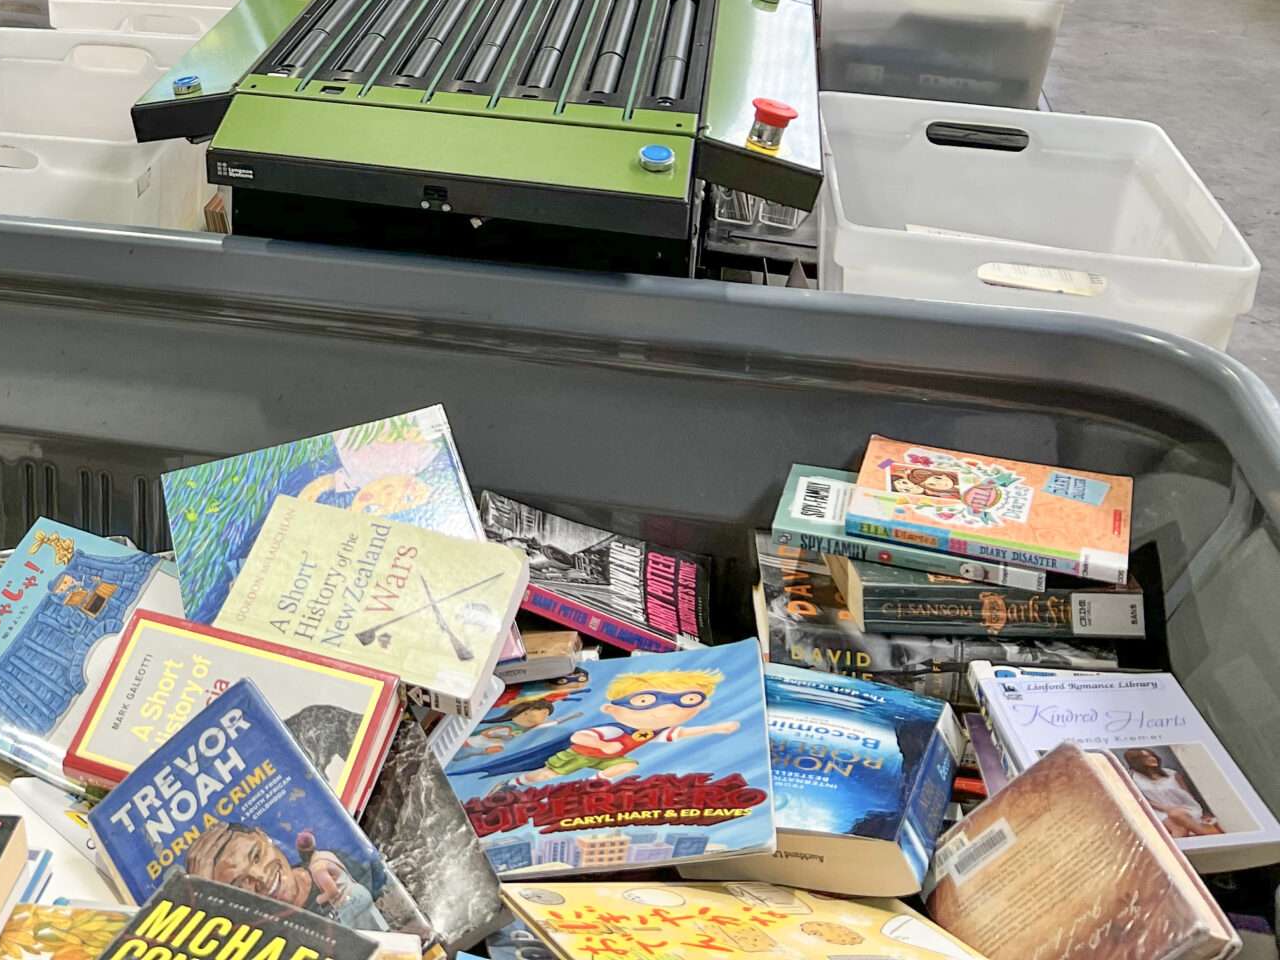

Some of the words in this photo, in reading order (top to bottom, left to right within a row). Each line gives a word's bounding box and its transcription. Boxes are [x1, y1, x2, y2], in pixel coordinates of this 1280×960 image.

[320, 610, 357, 649] New
[349, 523, 392, 603] Zealand
[365, 545, 418, 615] Wars
[609, 541, 643, 600] ROWLING
[646, 551, 675, 601] POTTER
[678, 559, 697, 588] STONE
[979, 545, 1008, 559] DIARY
[1011, 551, 1057, 568] DISASTER
[269, 617, 291, 635] A
[285, 549, 318, 614] Short
[293, 567, 349, 641] History
[647, 595, 679, 635] HARRY
[907, 603, 974, 619] SANSOM
[979, 591, 1041, 635] Dark
[791, 644, 871, 667] DAVID
[111, 704, 129, 731] MARK
[126, 653, 154, 701] GALEOTTI
[139, 658, 184, 721] Short
[1027, 682, 1065, 692] Linford
[1068, 681, 1114, 691] Romance
[1119, 680, 1158, 690] Library
[130, 724, 154, 742] A
[150, 680, 200, 752] istory
[1012, 703, 1099, 728] Kindred
[1105, 710, 1187, 733] Hearts
[110, 708, 252, 833] TREVOR
[144, 746, 247, 844] NOAH
[146, 826, 201, 881] BORN
[202, 812, 219, 832] A
[216, 759, 277, 817] CRIME
[470, 787, 768, 837] UPERHERO
[560, 813, 615, 827] CARYL
[618, 809, 662, 822] HART
[664, 809, 678, 818] &
[680, 808, 700, 817] ED
[704, 808, 752, 817] EAVES
[135, 898, 321, 960] MICHA
